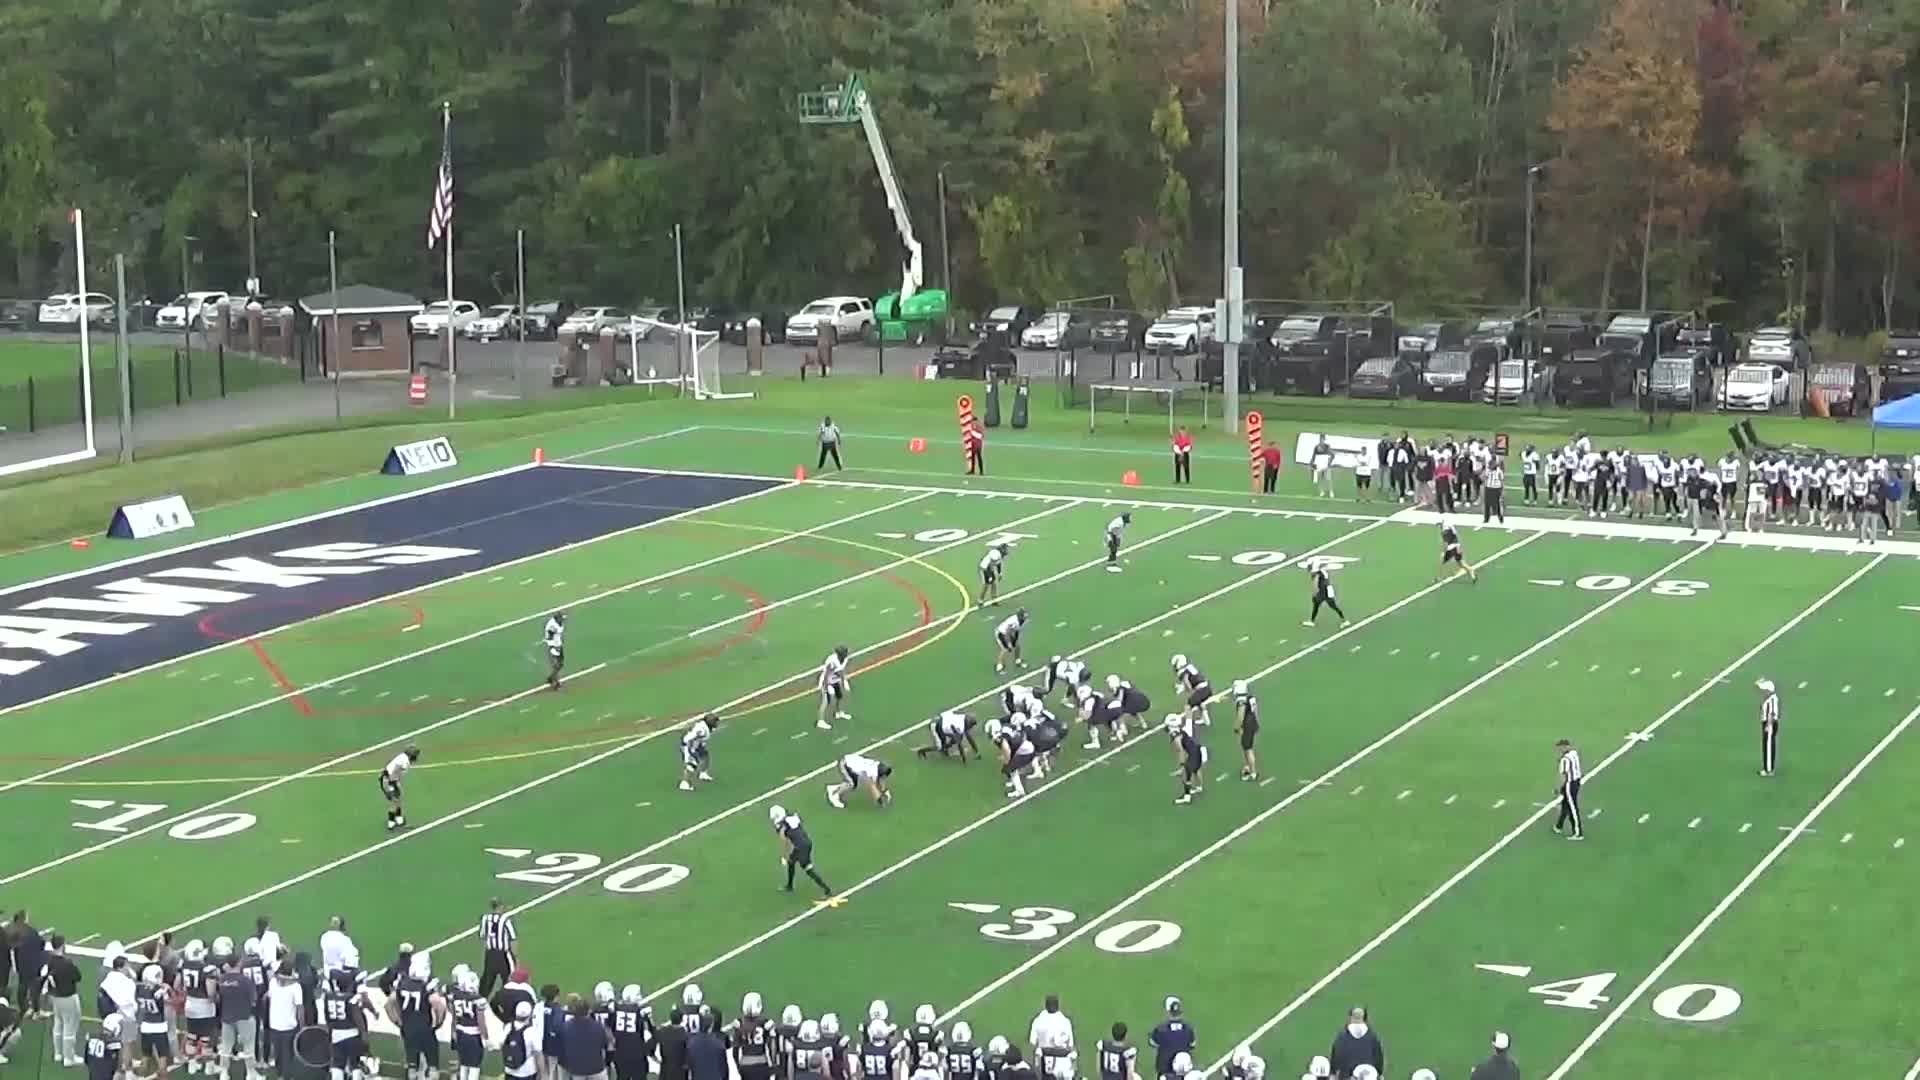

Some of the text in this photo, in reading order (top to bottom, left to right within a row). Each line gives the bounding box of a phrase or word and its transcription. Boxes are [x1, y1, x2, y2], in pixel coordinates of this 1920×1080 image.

[400, 990, 421, 1011] 77
[453, 999, 475, 1018] 54
[615, 1010, 637, 1033] 63
[1103, 1051, 1120, 1072] 18
